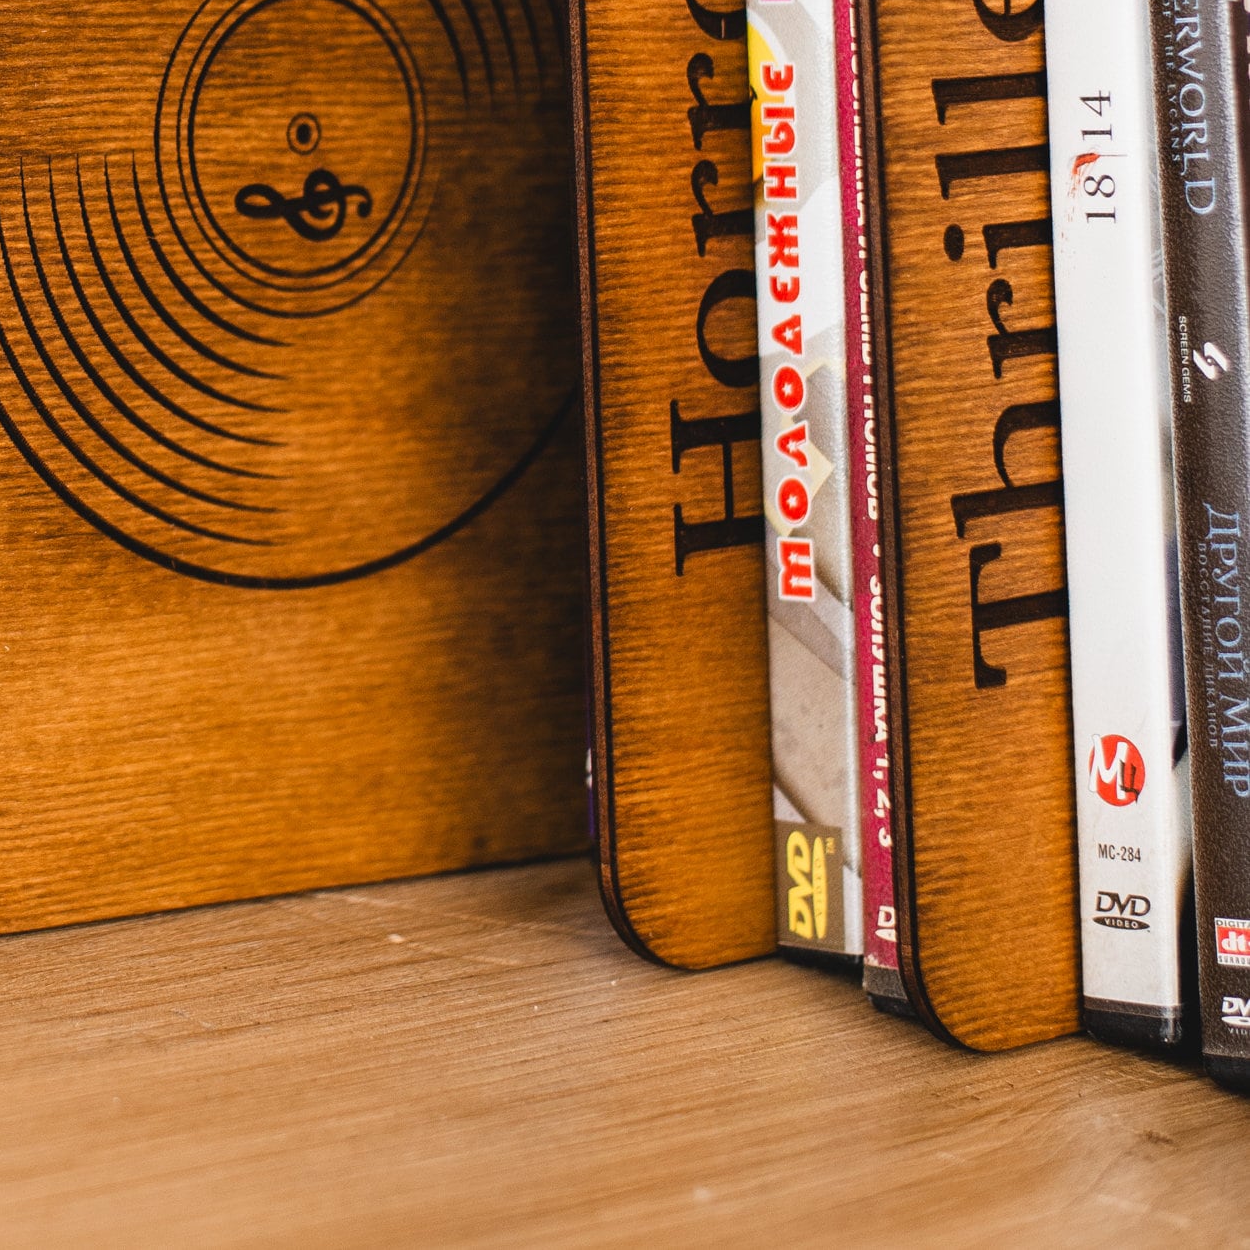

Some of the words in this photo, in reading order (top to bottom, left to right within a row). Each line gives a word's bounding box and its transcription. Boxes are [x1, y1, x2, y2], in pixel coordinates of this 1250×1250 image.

[1164, 32, 1174, 70] THE
[1166, 83, 1182, 162] LYCANS
[1178, 315, 1189, 364] SCREEN
[1181, 367, 1192, 403] GEMS
[786, 830, 813, 940] DVD
[1095, 890, 1151, 917] DVD
[1103, 917, 1139, 930] VIDEO
[1221, 931, 1250, 952] dt
